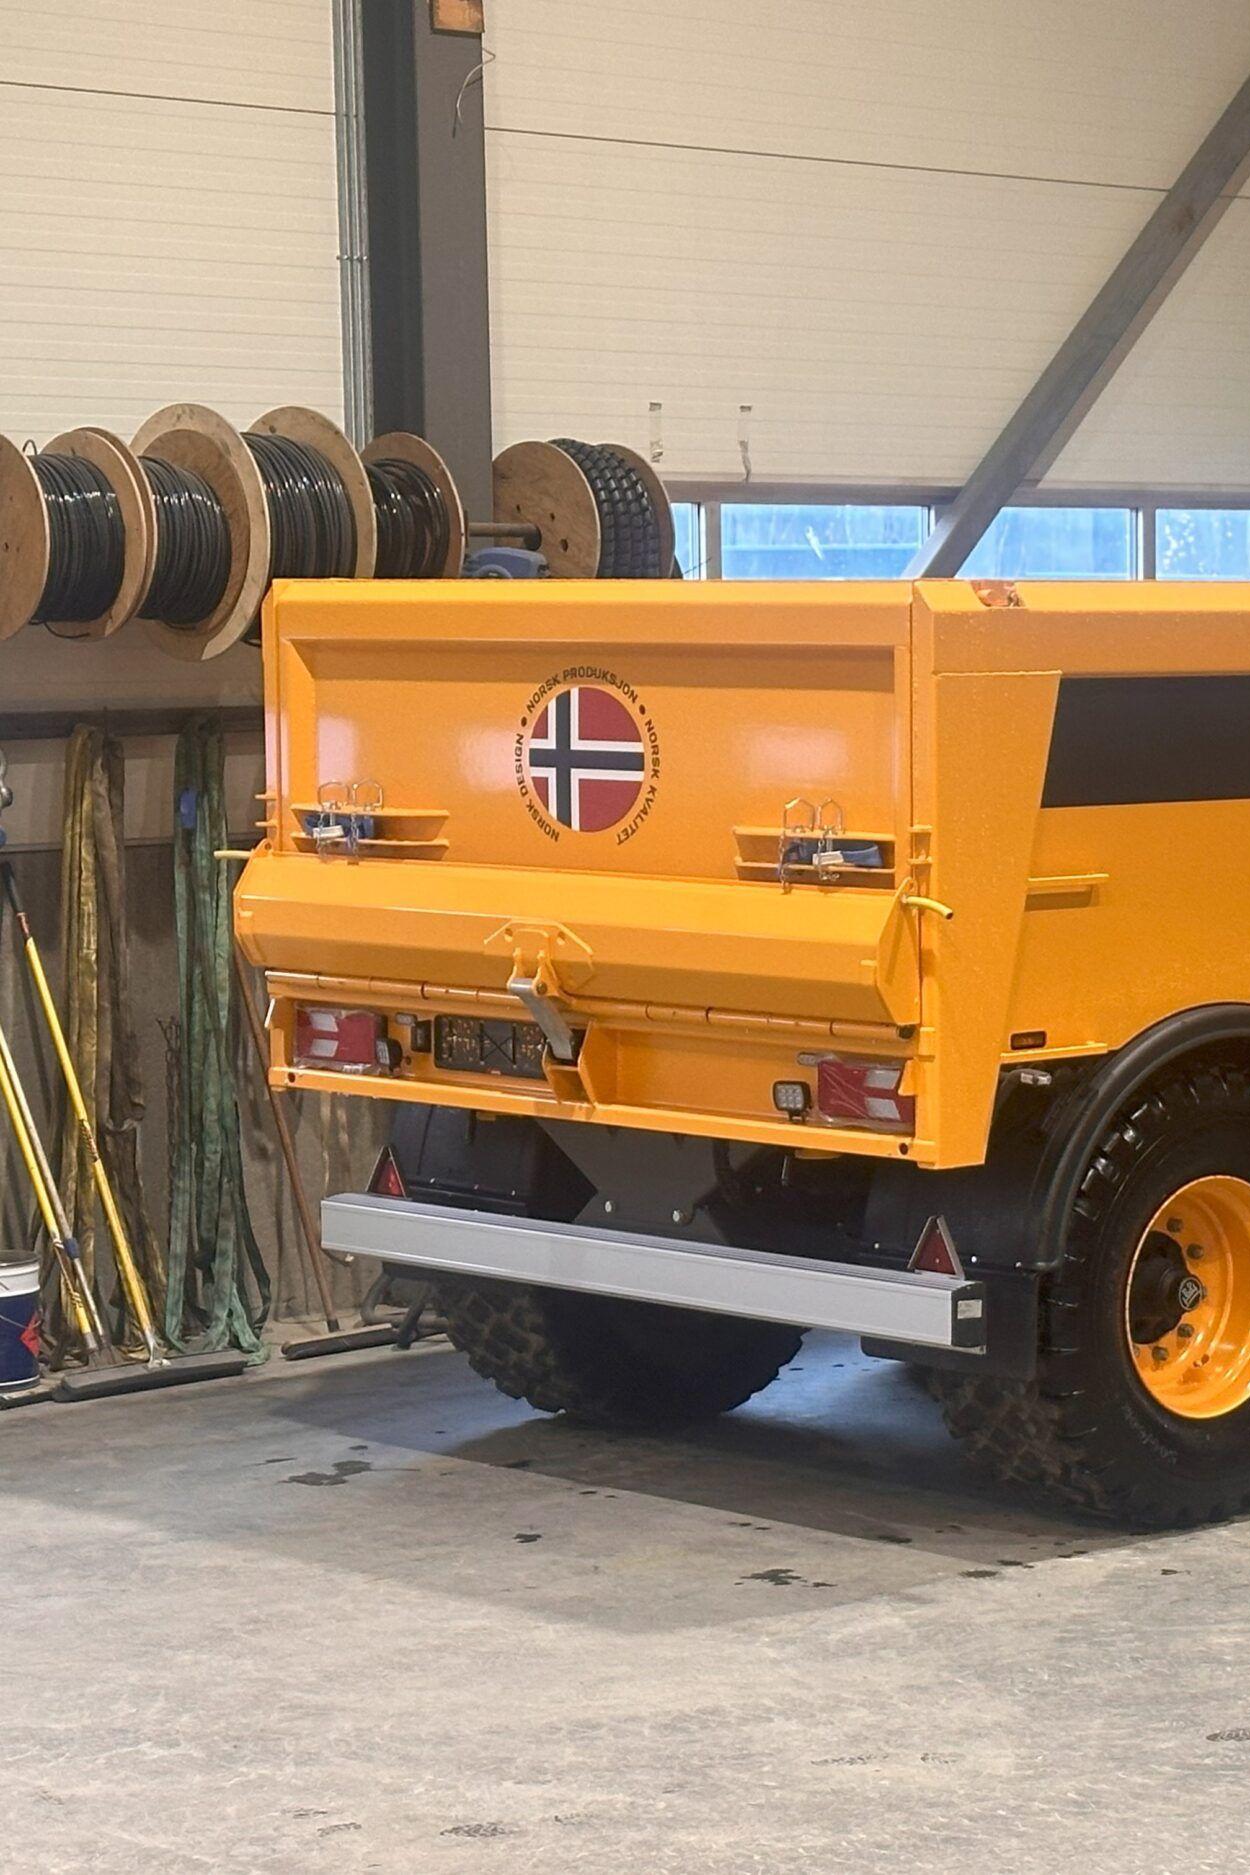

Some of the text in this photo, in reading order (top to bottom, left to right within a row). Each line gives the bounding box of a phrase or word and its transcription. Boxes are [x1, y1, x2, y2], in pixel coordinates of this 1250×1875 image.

[526, 665, 639, 714] NORSK PRODUKSJON
[514, 733, 560, 842] NORSK DESIGN
[616, 719, 660, 846] NORSK KVALITET
